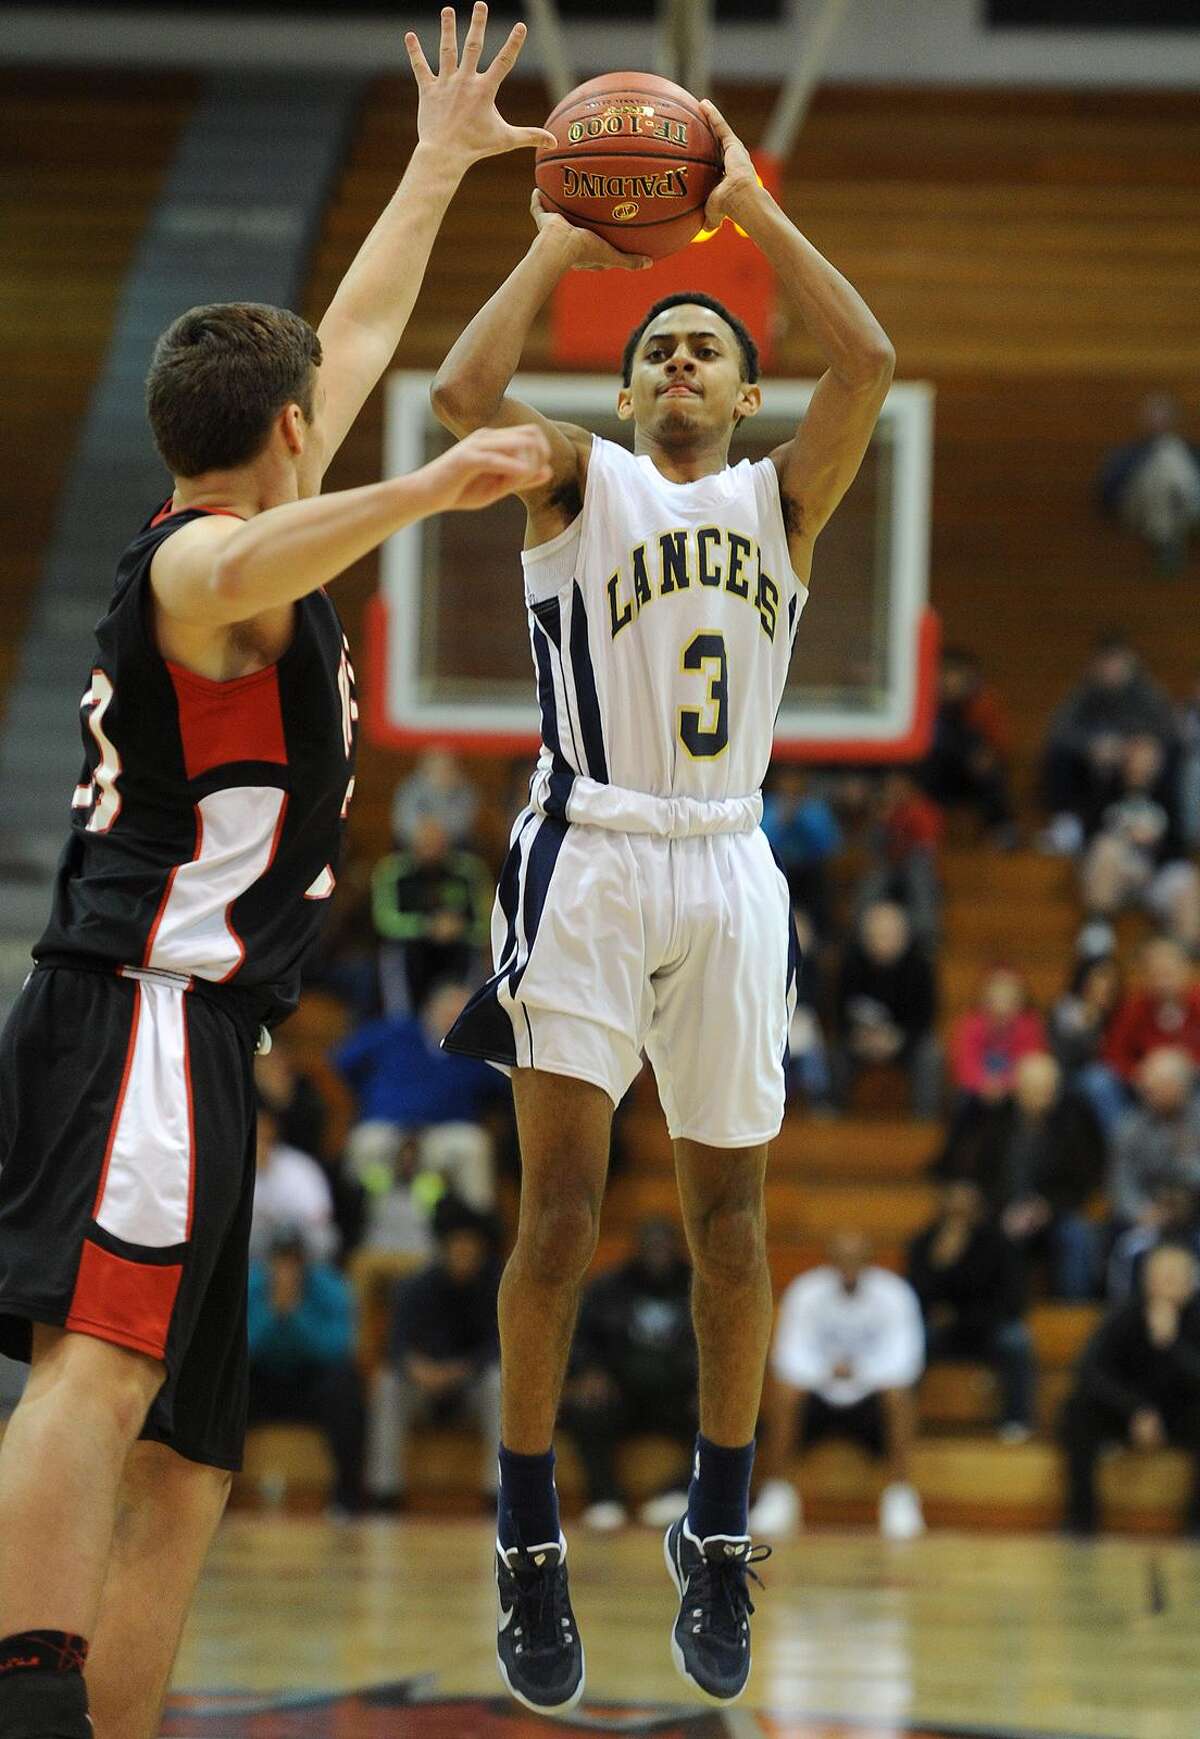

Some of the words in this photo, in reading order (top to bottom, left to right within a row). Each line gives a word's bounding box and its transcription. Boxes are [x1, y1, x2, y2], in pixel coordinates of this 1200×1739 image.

[568, 115, 688, 146] TF-1000
[562, 166, 688, 198] SPALDING
[677, 629, 730, 761] 3
